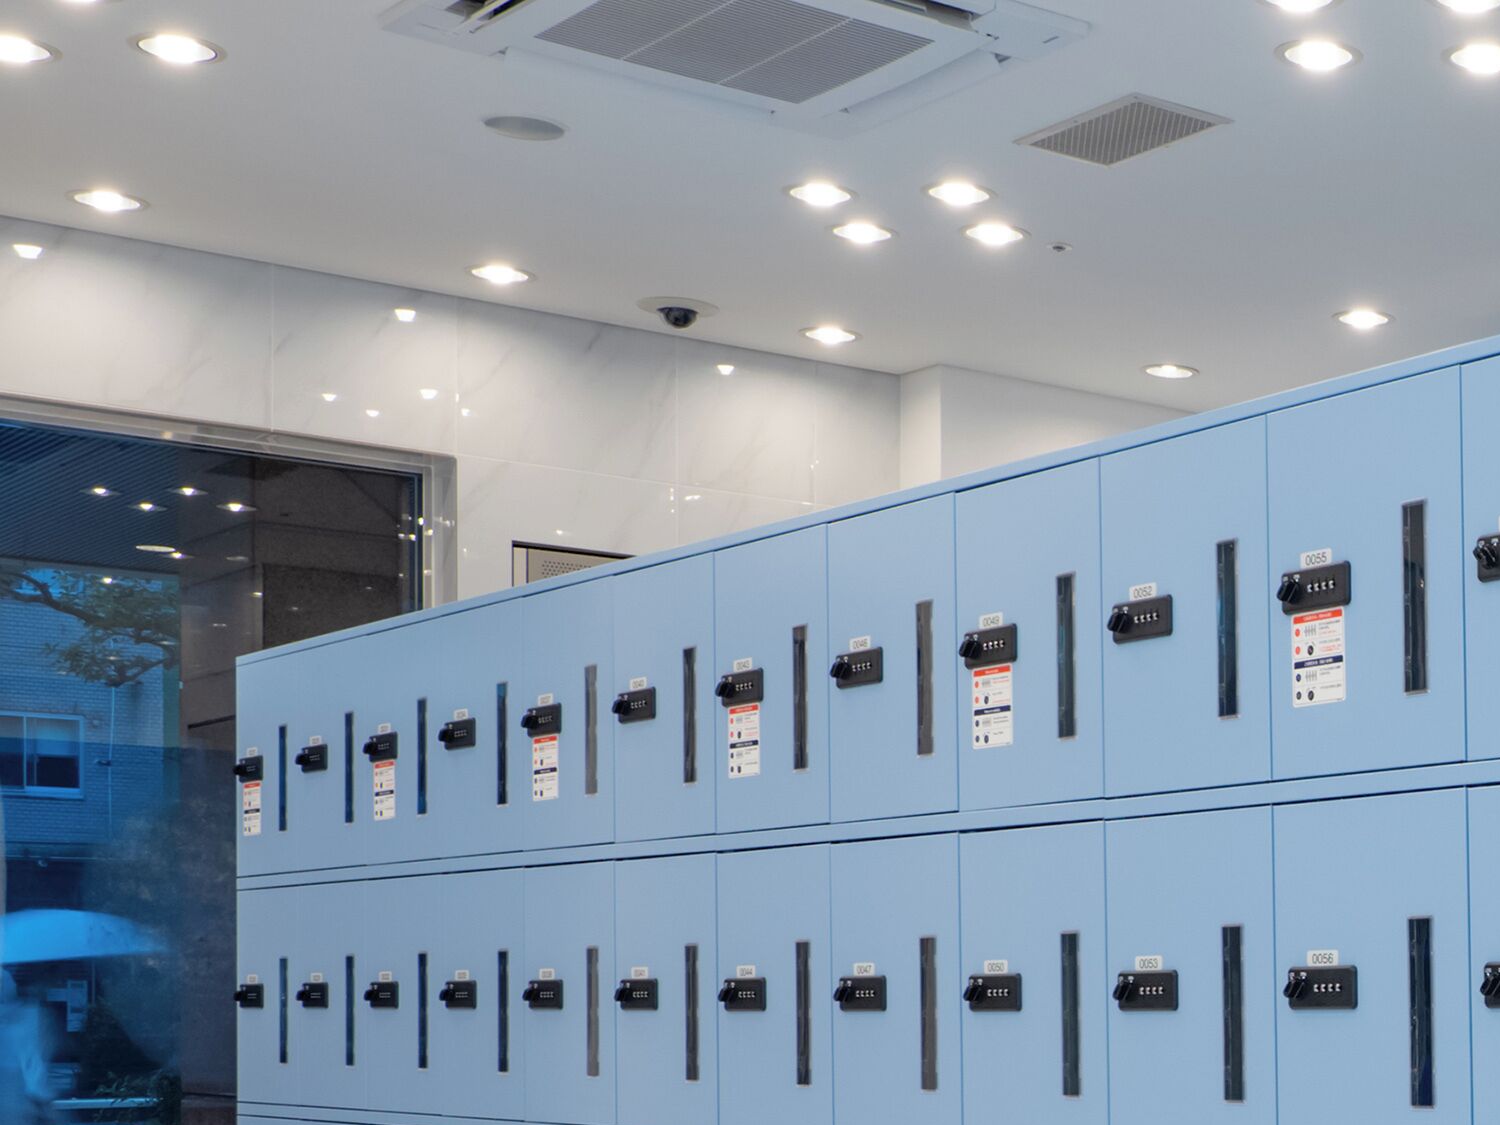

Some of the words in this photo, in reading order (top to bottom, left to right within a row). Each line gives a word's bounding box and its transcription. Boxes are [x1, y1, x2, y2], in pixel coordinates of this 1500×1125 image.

[1305, 551, 1328, 566] 0055
[1133, 585, 1153, 599] 0052
[1139, 958, 1158, 969] 0053
[1312, 952, 1334, 964] 0056
